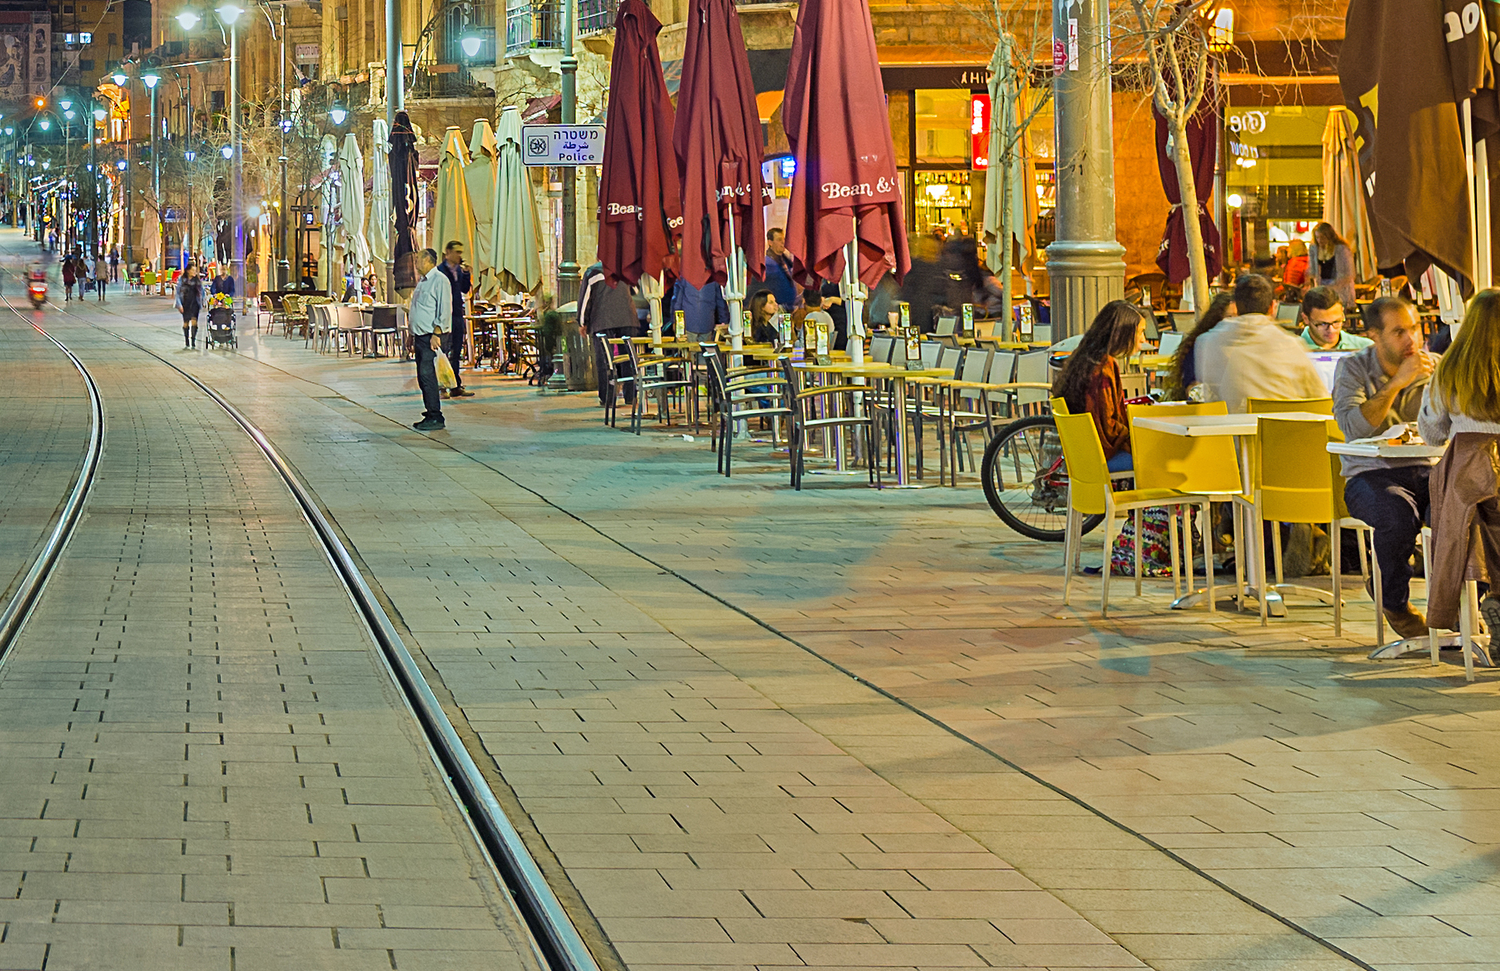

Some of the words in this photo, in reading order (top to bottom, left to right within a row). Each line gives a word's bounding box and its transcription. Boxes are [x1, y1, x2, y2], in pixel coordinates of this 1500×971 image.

[553, 130, 598, 140] משטרה
[562, 141, 589, 152] شرطة
[558, 152, 595, 161] Police
[821, 182, 873, 199] Bean
[876, 176, 891, 193] &
